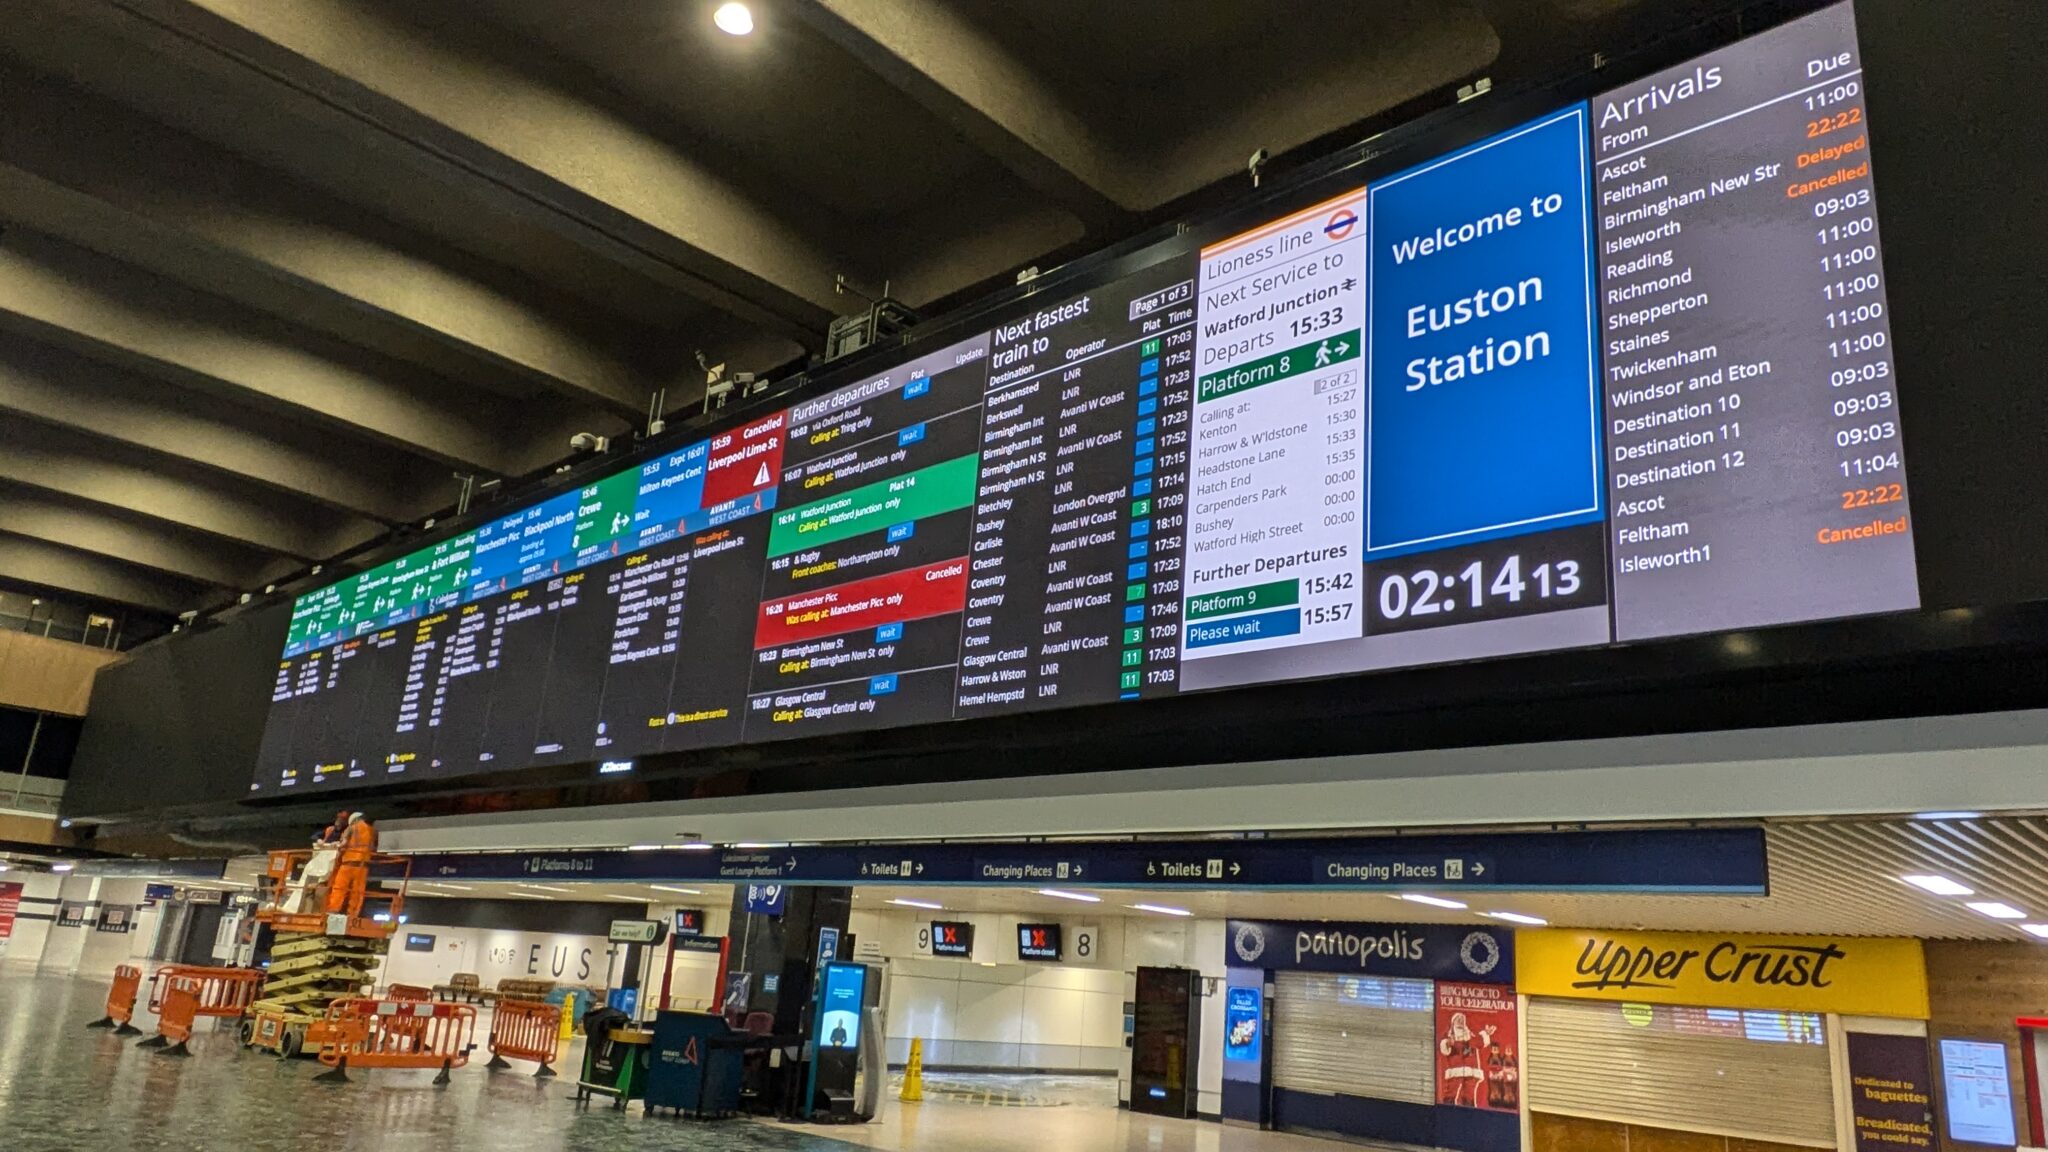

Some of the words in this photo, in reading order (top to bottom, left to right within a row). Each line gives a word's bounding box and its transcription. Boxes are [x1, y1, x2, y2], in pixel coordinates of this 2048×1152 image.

[1807, 52, 1851, 78] Due
[1600, 66, 1722, 129] Arrivals
[1805, 82, 1858, 111] 11:00
[1807, 107, 1861, 138] 22:22
[1602, 125, 1648, 152] From
[1796, 136, 1866, 168] Delayed
[1601, 156, 1647, 182] Ascot
[1786, 162, 1869, 198] Cancelled
[1603, 175, 1668, 206] Feltham
[1605, 186, 1706, 230] Birmingham
[1711, 173, 1750, 196] New
[1754, 163, 1781, 182] Str
[1814, 189, 1870, 217] 09:03
[1392, 207, 1522, 264] Welcome
[1530, 194, 1562, 218] to
[1606, 220, 1681, 254] Isleworth
[1818, 217, 1873, 244] 11:00
[1208, 244, 1274, 280] Lioness
[1279, 231, 1313, 254] line
[1607, 250, 1673, 279] Reading
[1206, 285, 1247, 313] Next
[1251, 262, 1318, 296] Service
[1323, 253, 1344, 271] to
[1608, 267, 1692, 305] Richmond
[1135, 298, 1158, 314] Page
[1160, 291, 1166, 304] 1
[1168, 287, 1180, 301] of
[1181, 285, 1188, 297] 3
[1204, 305, 1266, 338] Watford
[1268, 285, 1338, 322] Junction
[1408, 277, 1542, 338] Euston
[1608, 289, 1708, 330] Shepperton
[995, 320, 1032, 346] Next
[1034, 296, 1090, 329] fastest
[1142, 318, 1161, 333] Plat
[1168, 308, 1193, 324] Time
[1826, 302, 1882, 329] 11:00
[1065, 338, 1106, 360] Operator
[1166, 330, 1192, 347] 17:03
[1204, 331, 1274, 366] Departs
[1290, 306, 1343, 338] 15:33
[1610, 330, 1670, 356] Staines
[955, 348, 984, 365] Update
[992, 343, 1029, 369] train
[1032, 336, 1049, 354] to
[1165, 349, 1191, 367] 17:52
[1406, 331, 1550, 392] Station
[1610, 345, 1717, 381] Twickenham
[989, 364, 1035, 387] Destination
[1063, 367, 1081, 382] LNR
[1202, 365, 1274, 396] Platform
[1279, 356, 1290, 373] 8
[1611, 380, 1684, 408] Windsor
[1688, 370, 1723, 391] and
[1728, 361, 1771, 381] Eton
[1831, 361, 1889, 387] 09:03
[792, 399, 830, 423] Further
[830, 375, 891, 408] departures
[988, 381, 1040, 407] Berkhamsted
[1326, 388, 1357, 406] 15:27
[1200, 407, 1235, 424] Calling
[1237, 402, 1251, 414] at:
[1327, 408, 1357, 425] 15:30
[1614, 403, 1712, 435] Destination
[1718, 393, 1741, 412] 10
[712, 435, 732, 451] 15:59
[743, 415, 783, 439] Cancelled
[1198, 441, 1238, 459] Harrow
[1240, 436, 1249, 448] &
[1251, 423, 1308, 445] W'ldstone
[1199, 423, 1237, 441] Kenton
[1326, 428, 1356, 445] 15:33
[1615, 431, 1714, 462] Destination
[1720, 422, 1740, 440] 11
[1836, 422, 1896, 447] 09:03
[707, 447, 746, 471] Liverpool
[746, 442, 768, 458] Lime
[767, 437, 778, 450] St
[1197, 455, 1256, 478] Headstone
[1258, 448, 1286, 463] Lane
[1326, 448, 1356, 465] 15:35
[1840, 452, 1900, 477] 11:04
[1616, 459, 1716, 489] Destination
[1722, 450, 1745, 469] 12
[889, 480, 905, 492] Plat
[905, 477, 916, 490] 14
[1196, 479, 1228, 497] Hatch
[1230, 472, 1252, 489] End
[1843, 483, 1902, 510] 22:22
[578, 501, 602, 517] Crewe
[1195, 493, 1259, 515] Carpenders
[1261, 484, 1287, 501] Park
[1616, 495, 1665, 517] Ascot
[1195, 517, 1234, 534] Bushey
[1323, 510, 1355, 527] 00:00
[1817, 516, 1908, 544] Cancelled
[1193, 533, 1237, 553] Watford
[1240, 528, 1266, 544] High
[1268, 521, 1303, 538] Street
[1619, 522, 1689, 545] Feltham
[837, 549, 884, 568] Northampton
[883, 544, 900, 557] only
[972, 556, 1004, 571] Chester
[1193, 563, 1251, 584] Further
[1254, 545, 1348, 574] Departures
[1620, 544, 1710, 573] Isleworth1
[925, 563, 963, 581] Cancelled
[1305, 572, 1353, 595] 15:42
[1379, 555, 1526, 619] 02:14
[1532, 560, 1580, 598] 13
[1191, 595, 1244, 613] Platform
[1247, 590, 1257, 605] 9
[1304, 602, 1353, 626] 15:57
[1190, 626, 1230, 642] Please
[1233, 619, 1261, 636] wait
[963, 654, 997, 668] Glasgow
[997, 646, 1028, 662] Central
[961, 674, 991, 687] Harrow
[999, 669, 1027, 681] Wston
[870, 863, 898, 876] Toilets
[983, 864, 1022, 879] Changing
[1024, 864, 1053, 877] Places
[1161, 862, 1203, 876] Toilets
[1327, 863, 1390, 880] Changing
[1393, 863, 1437, 878] Places
[684, 939, 718, 948] Information
[918, 928, 929, 949] 9
[1077, 933, 1091, 957] 8
[1295, 929, 1424, 967] panopolis
[1022, 948, 1041, 956] Platform
[1572, 938, 1700, 990] Upper
[1704, 940, 1846, 988] Crust
[1488, 988, 1500, 999] TO
[1854, 1077, 1901, 1090] Dedicated
[1903, 1081, 1914, 1090] to
[1865, 1088, 1929, 1104] baguettes
[1862, 1131, 1880, 1141] you
[1881, 1131, 1909, 1143] could
[1911, 1136, 1930, 1147] say.
